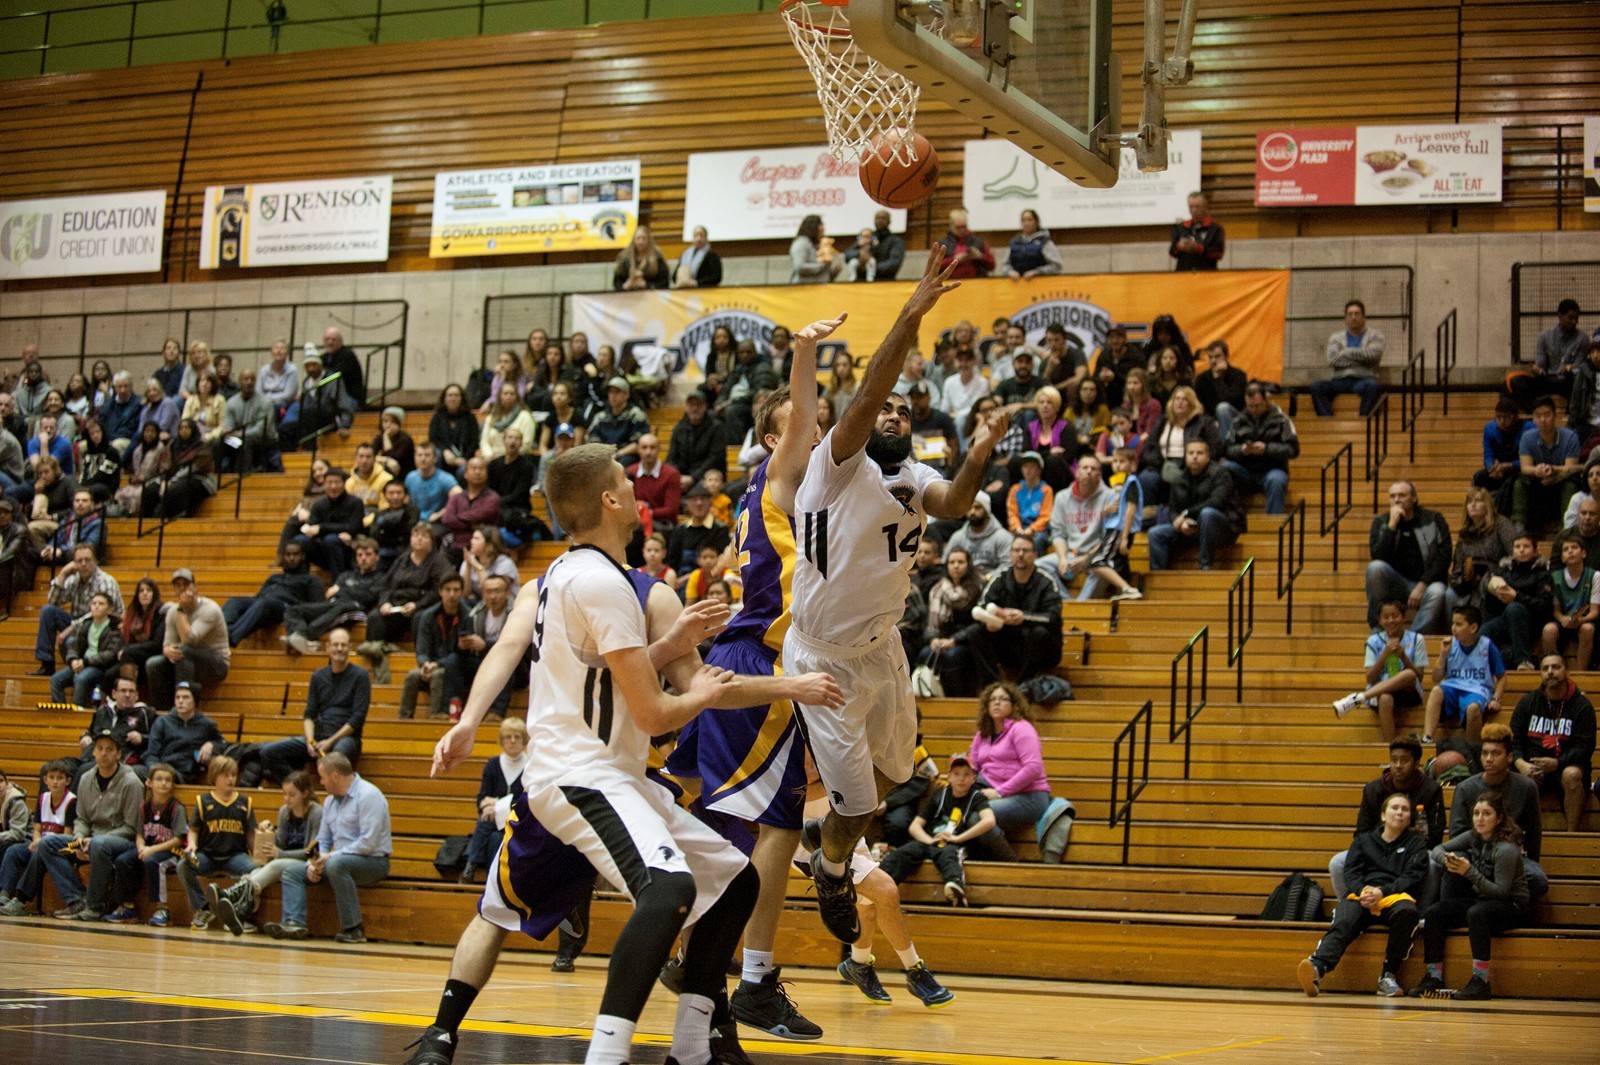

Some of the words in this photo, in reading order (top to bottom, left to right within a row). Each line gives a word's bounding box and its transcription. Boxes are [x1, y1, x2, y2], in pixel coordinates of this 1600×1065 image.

[1395, 133, 1432, 144] Arrive
[1434, 129, 1471, 142] empty
[1418, 138, 1461, 154] Leave
[1464, 138, 1489, 154] full
[1300, 153, 1328, 164] PLAZA
[446, 171, 514, 187] ATHLETICS
[518, 169, 546, 181] AND
[549, 164, 634, 179] RECREATION
[1434, 179, 1450, 191] ALL
[1464, 178, 1482, 191] EAT
[282, 187, 384, 223] RENISON
[62, 206, 157, 234] EDUCATION
[60, 238, 108, 260] CREDIT
[112, 236, 155, 256] UNION
[881, 522, 922, 563] 14
